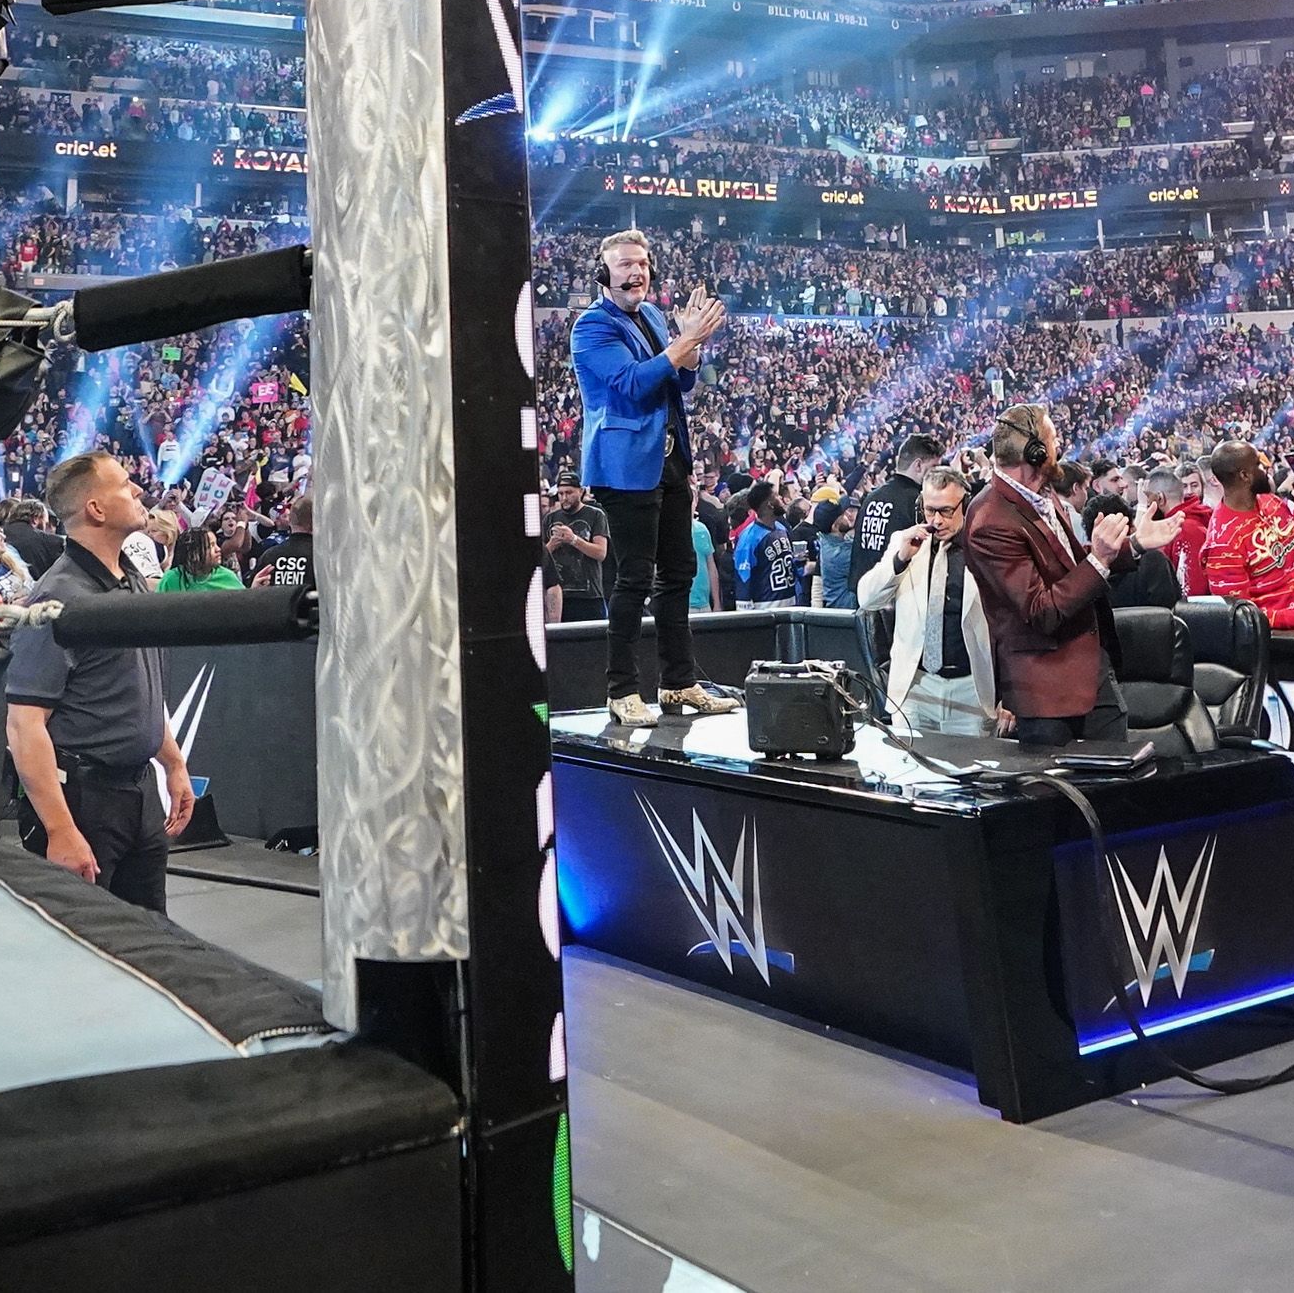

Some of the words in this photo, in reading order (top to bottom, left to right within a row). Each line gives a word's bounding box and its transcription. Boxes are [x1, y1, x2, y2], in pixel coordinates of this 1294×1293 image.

[768, 6, 790, 18] BILL
[794, 9, 830, 22] POLIAN
[835, 14, 868, 27] 1998-11
[234, 148, 308, 174] ROYA
[623, 175, 693, 197] ROYAL
[696, 178, 778, 202] RUMBLE
[944, 195, 1006, 214] ROYAL
[1009, 190, 1098, 212] RUMBLE
[1208, 316, 1226, 326] 121
[866, 501, 893, 517] CSC
[862, 517, 888, 534] EVENT
[861, 534, 885, 551] STAFF
[275, 556, 307, 571] CSC
[274, 571, 306, 586] EVENT
